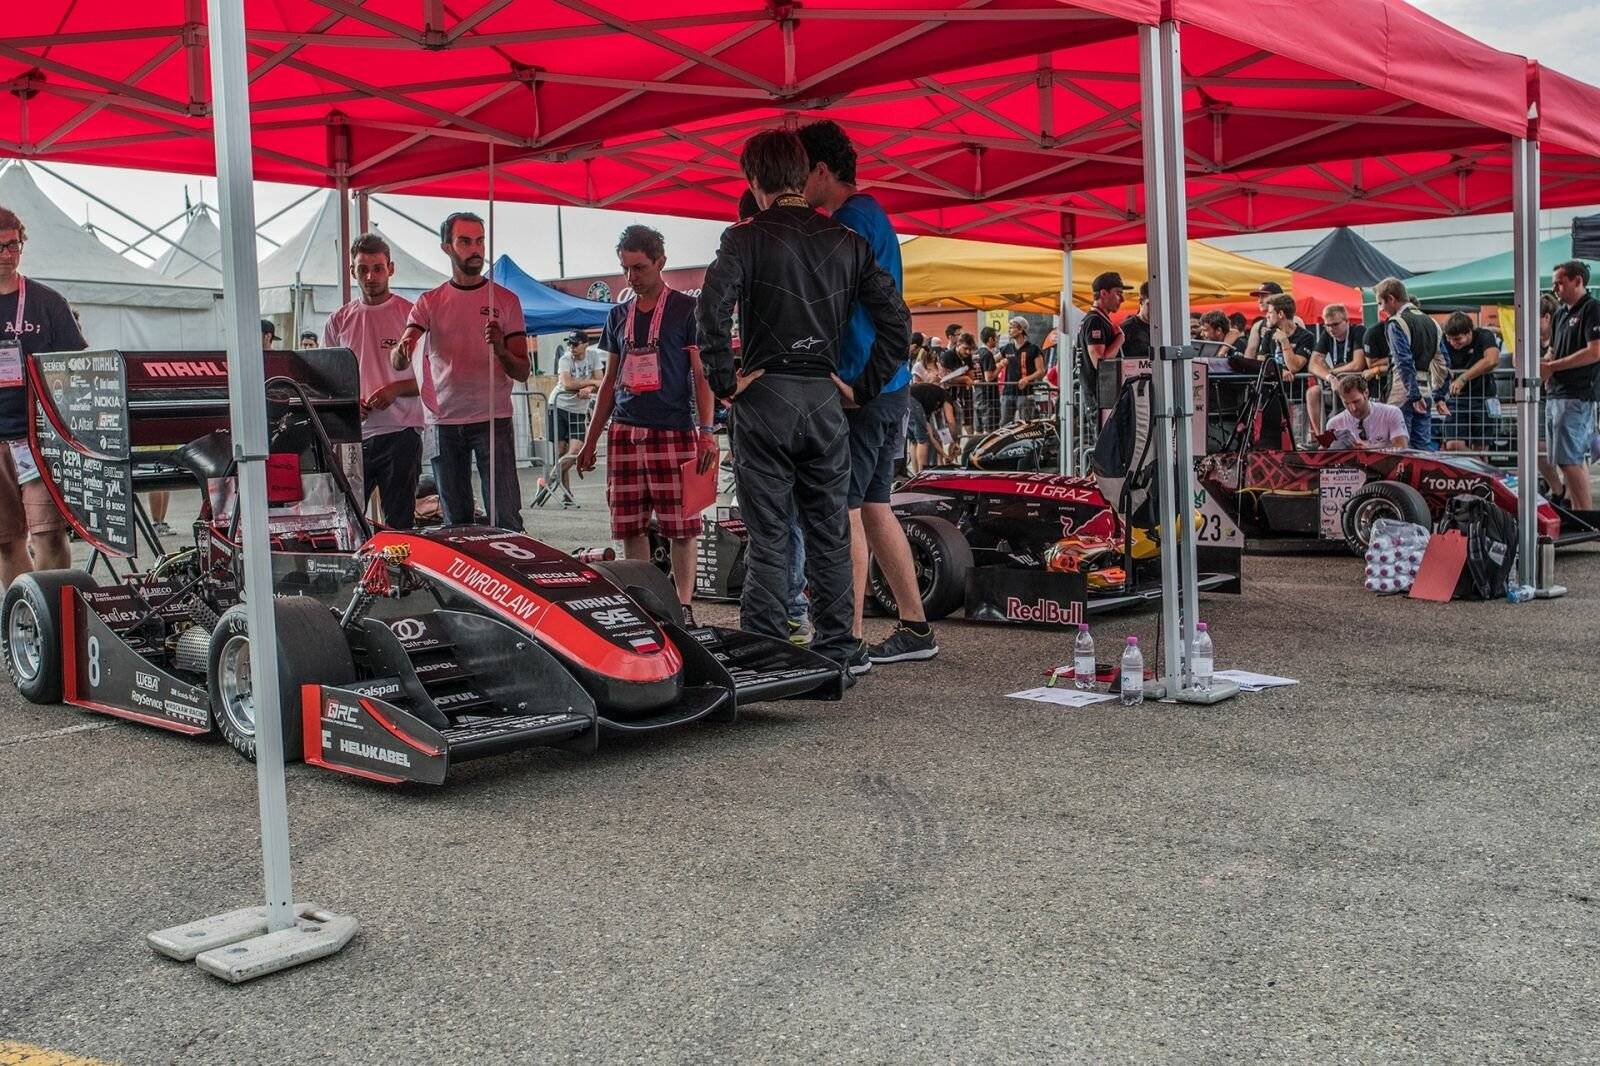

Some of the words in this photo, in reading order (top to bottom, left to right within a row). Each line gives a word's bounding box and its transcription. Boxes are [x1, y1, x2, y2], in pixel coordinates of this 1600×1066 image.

[92, 357, 119, 371] MAHLE
[143, 361, 228, 377] MAHL
[94, 397, 121, 408] NOKIA
[78, 418, 94, 430] Altair
[62, 450, 81, 467] CEPA
[1016, 483, 1039, 494] TU
[1041, 485, 1093, 502] GRAZ
[1320, 487, 1352, 498] ETAS
[112, 502, 126, 511] BOSCH
[1198, 514, 1221, 541] 23
[489, 541, 536, 560] 8
[446, 557, 465, 578] TU
[464, 567, 541, 620] WROCLAW
[565, 595, 630, 611] MAHLE
[591, 607, 640, 625] SAE
[87, 635, 100, 687] 8
[414, 662, 458, 673] ADPOL
[340, 739, 411, 768] HELUKABEL
